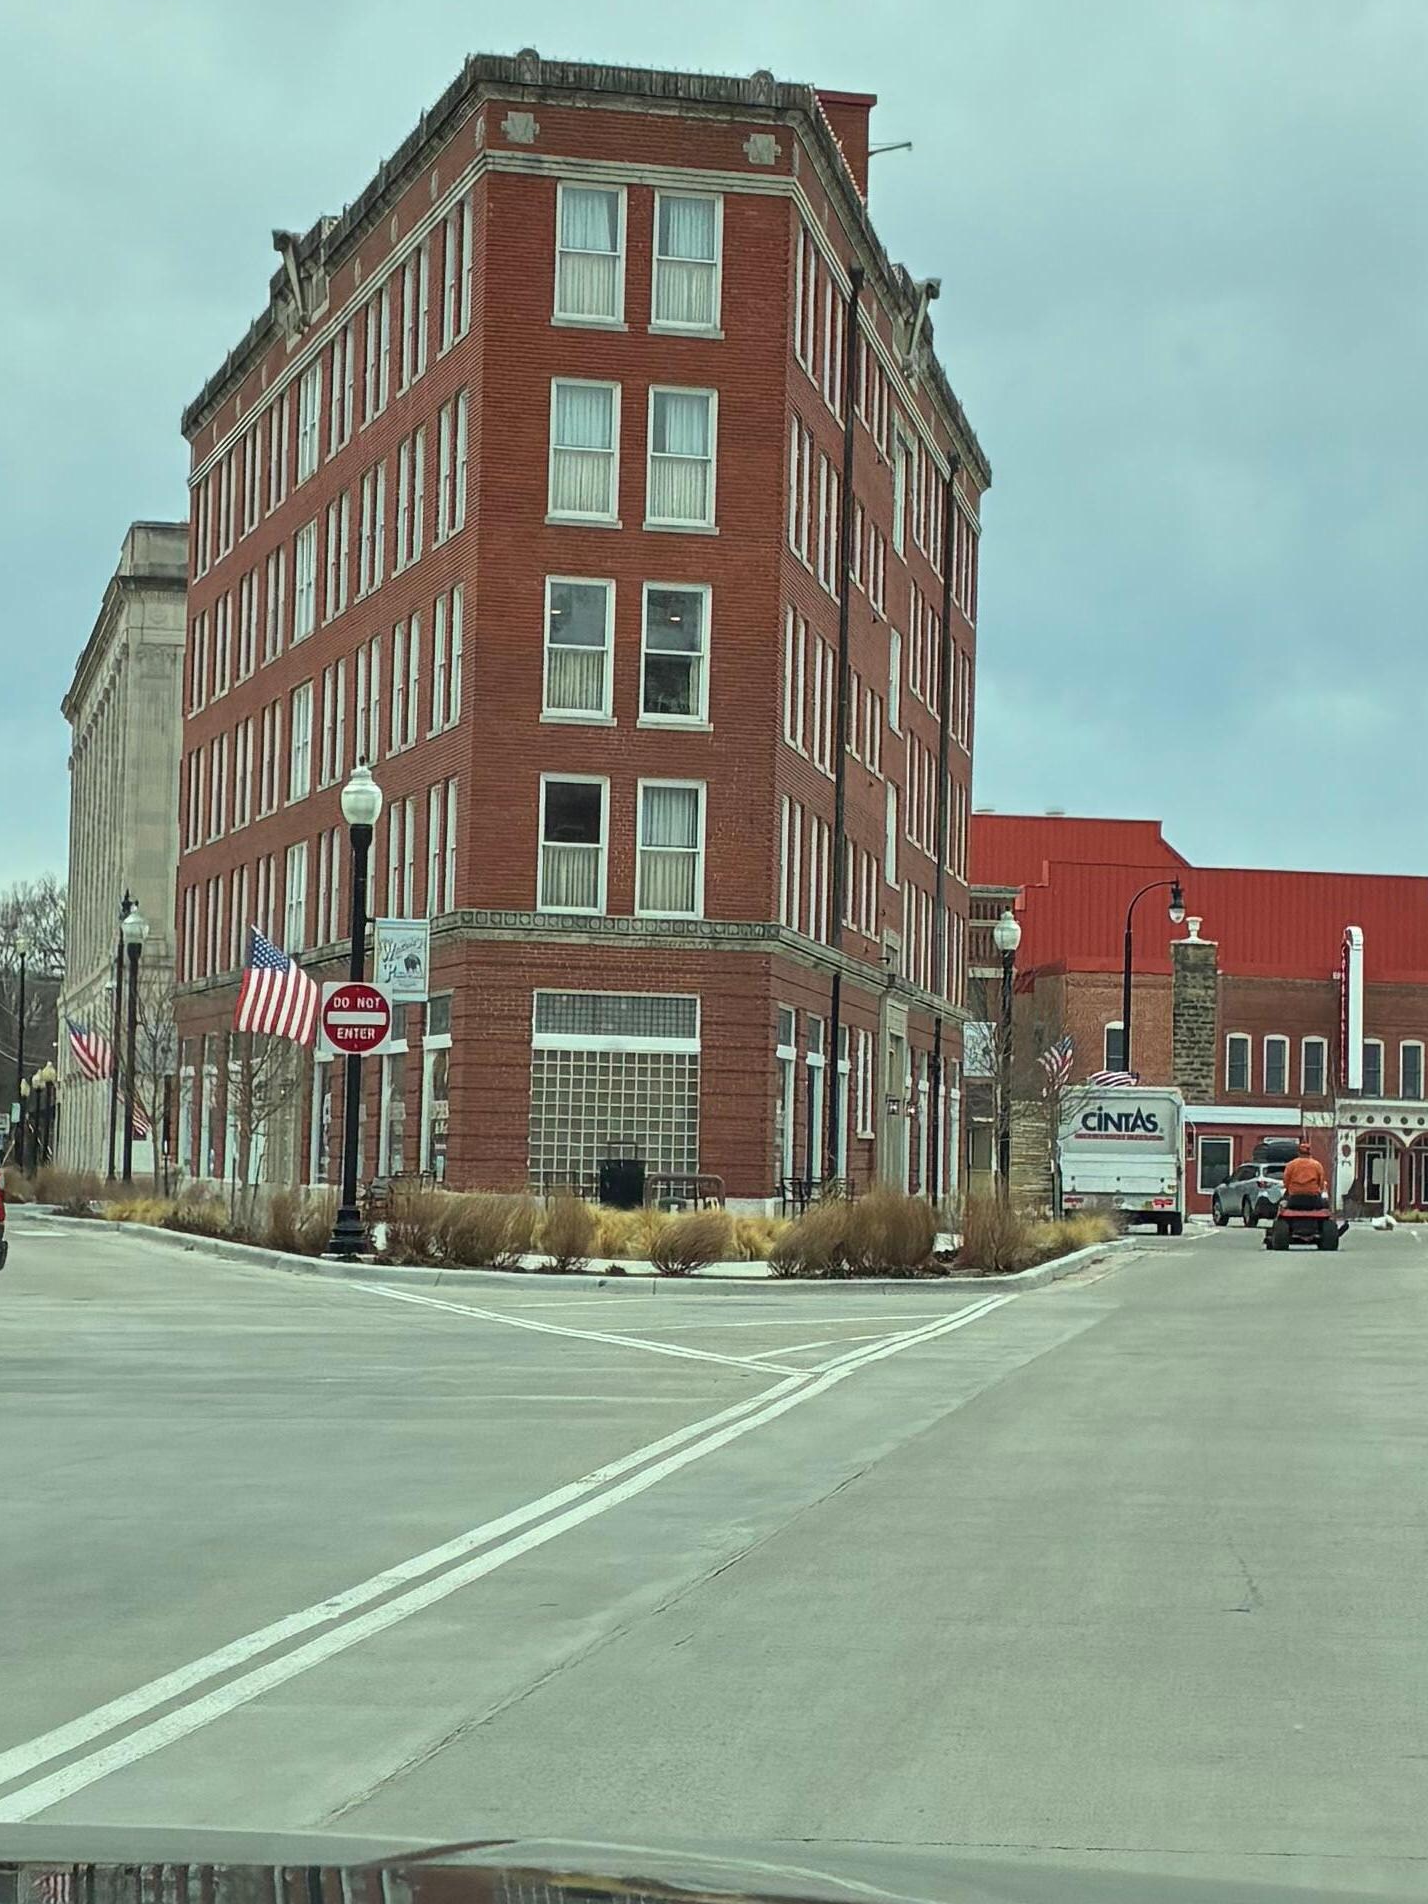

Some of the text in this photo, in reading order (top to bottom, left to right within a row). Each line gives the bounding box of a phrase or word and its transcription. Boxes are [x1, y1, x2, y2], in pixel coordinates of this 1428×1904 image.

[333, 997, 381, 1008] DO NOT
[337, 1028, 375, 1039] ENTER
[1080, 1105, 1159, 1133] CINTAS
